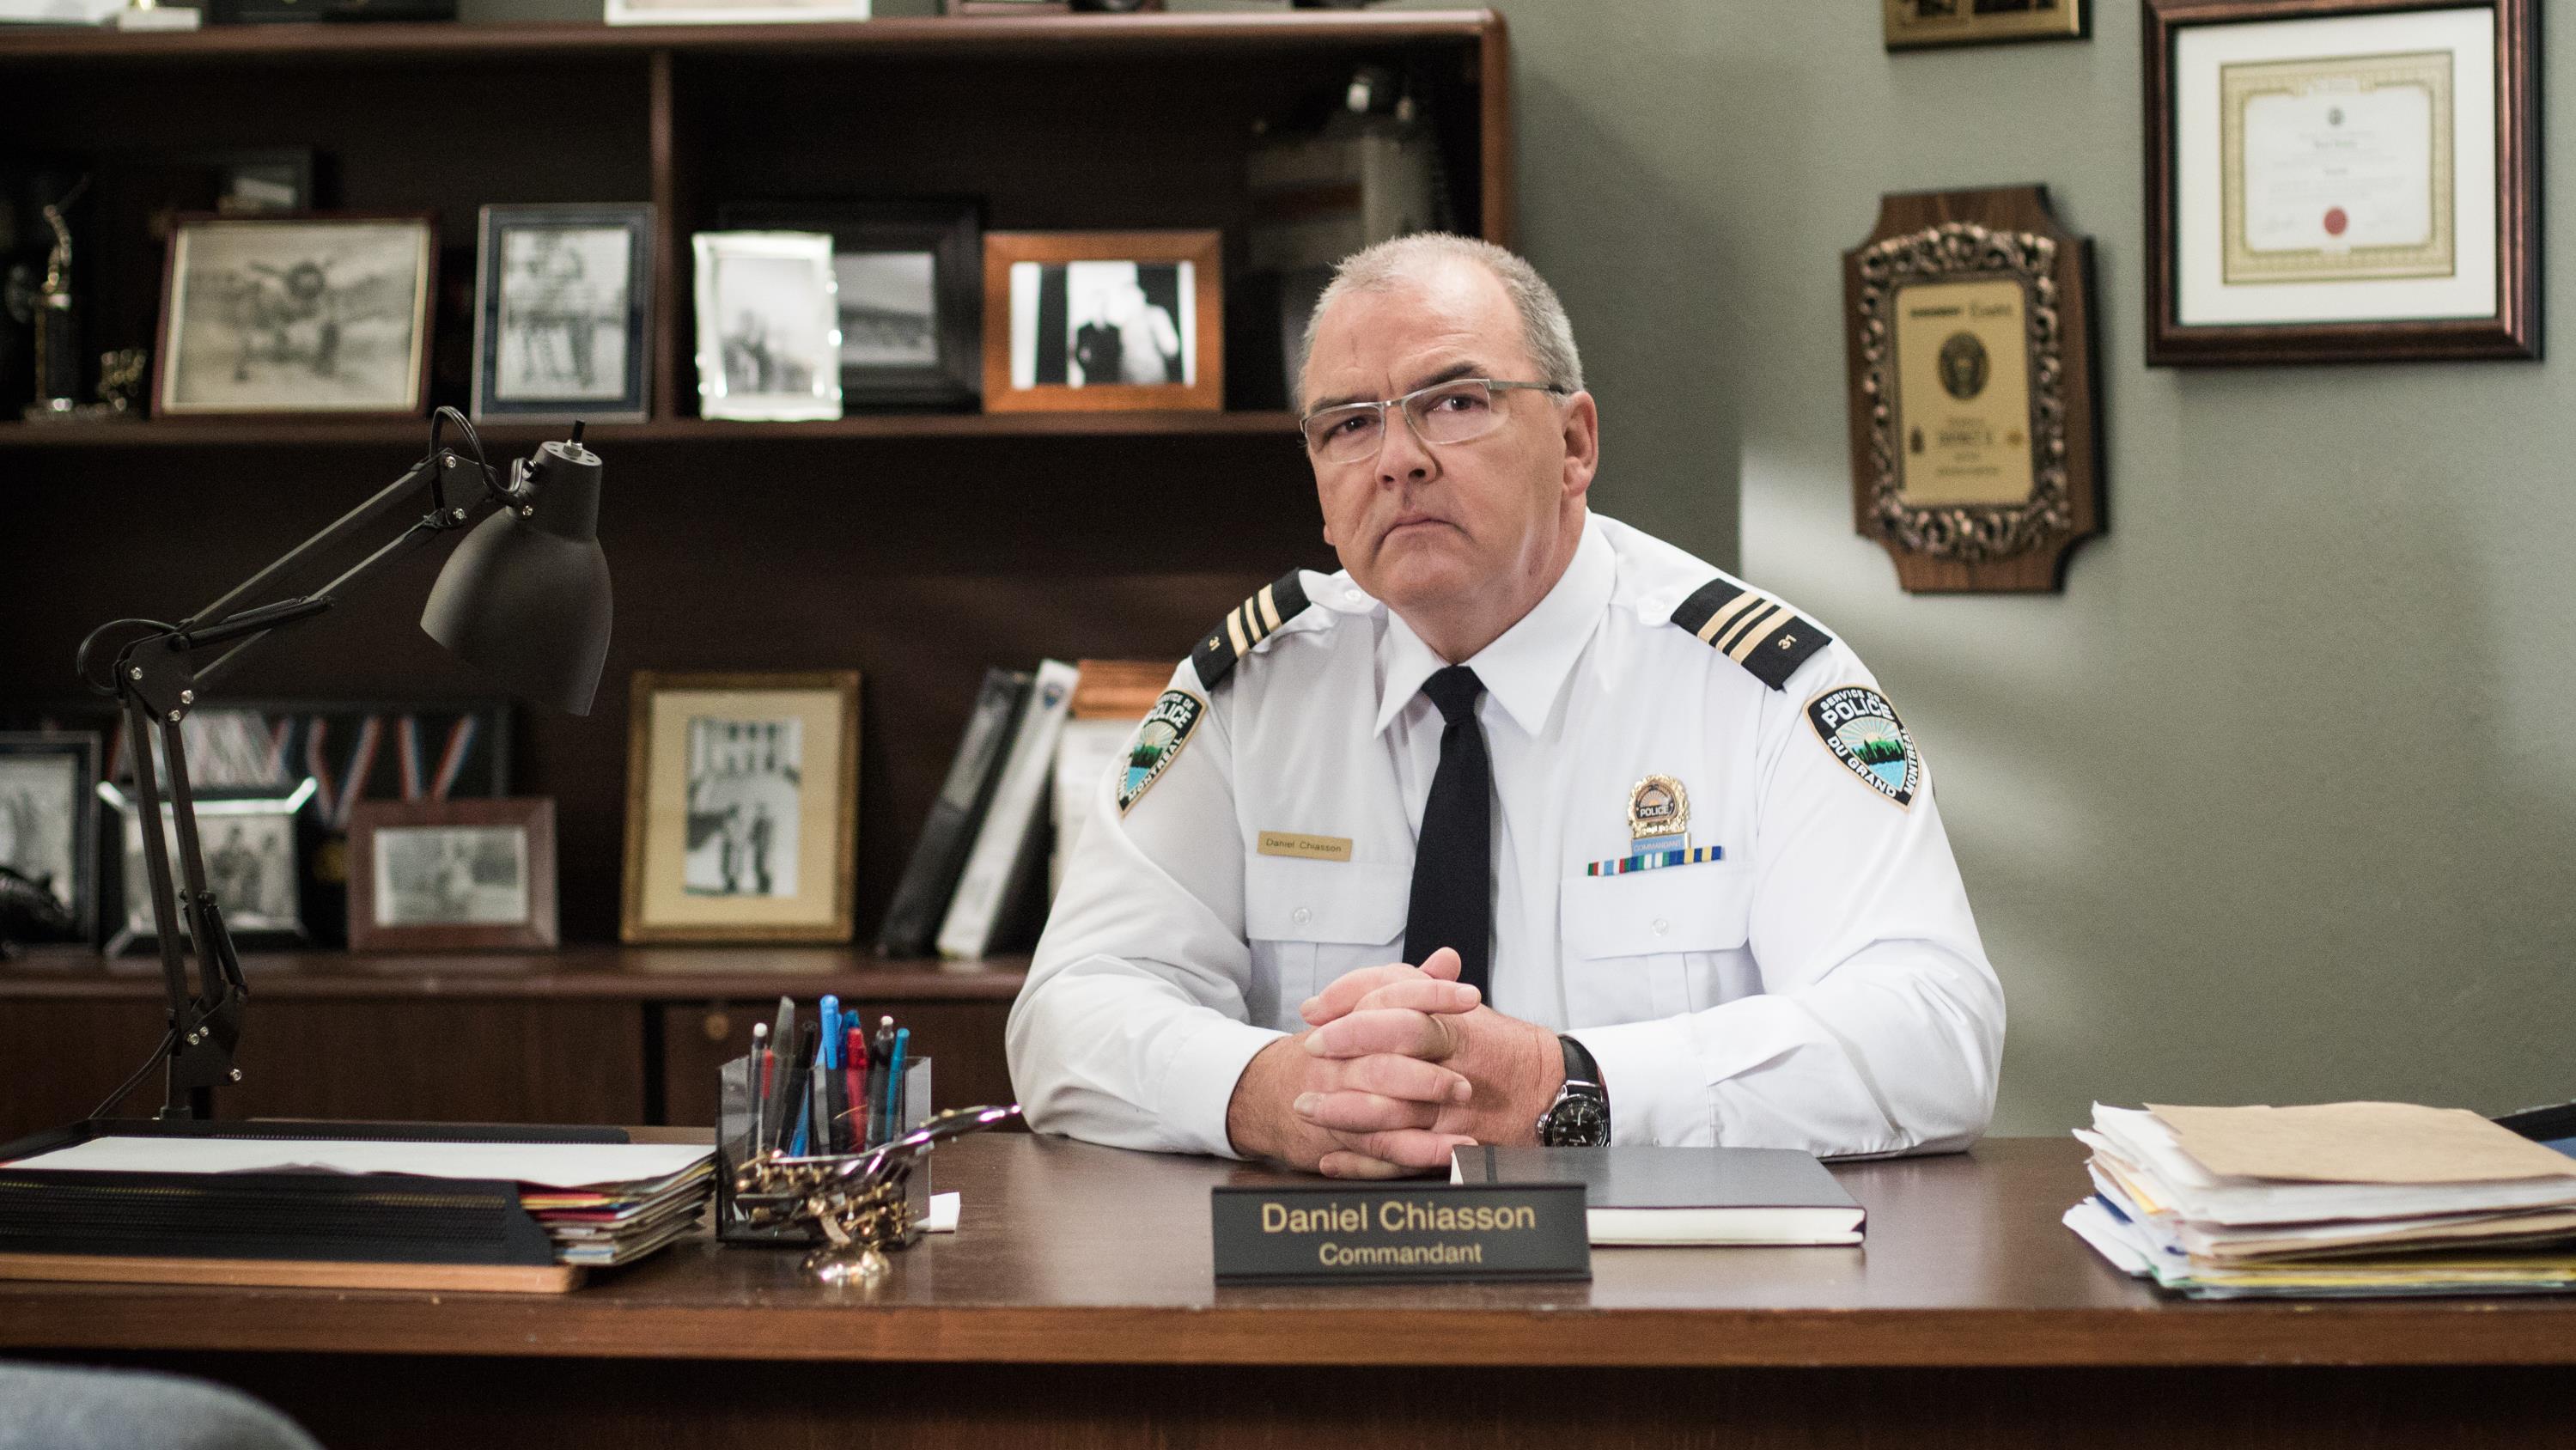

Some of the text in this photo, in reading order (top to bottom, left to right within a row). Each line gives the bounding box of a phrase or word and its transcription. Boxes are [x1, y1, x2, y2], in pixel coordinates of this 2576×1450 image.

[1778, 634, 1797, 649] 31
[1820, 689, 1881, 711] SERVICE DE
[1152, 702, 1192, 729] OLICE
[1821, 698, 1895, 729] POLICE
[1128, 736, 1183, 801] MONTREAL
[1827, 728, 1918, 798] DU GRAND MONTREAL
[1640, 805, 1670, 817] POLICE
[1265, 838, 1342, 852] Daniel Chiasson
[1262, 1201, 1536, 1233] Daniel Chiasson
[1318, 1242, 1482, 1265] Commandant
